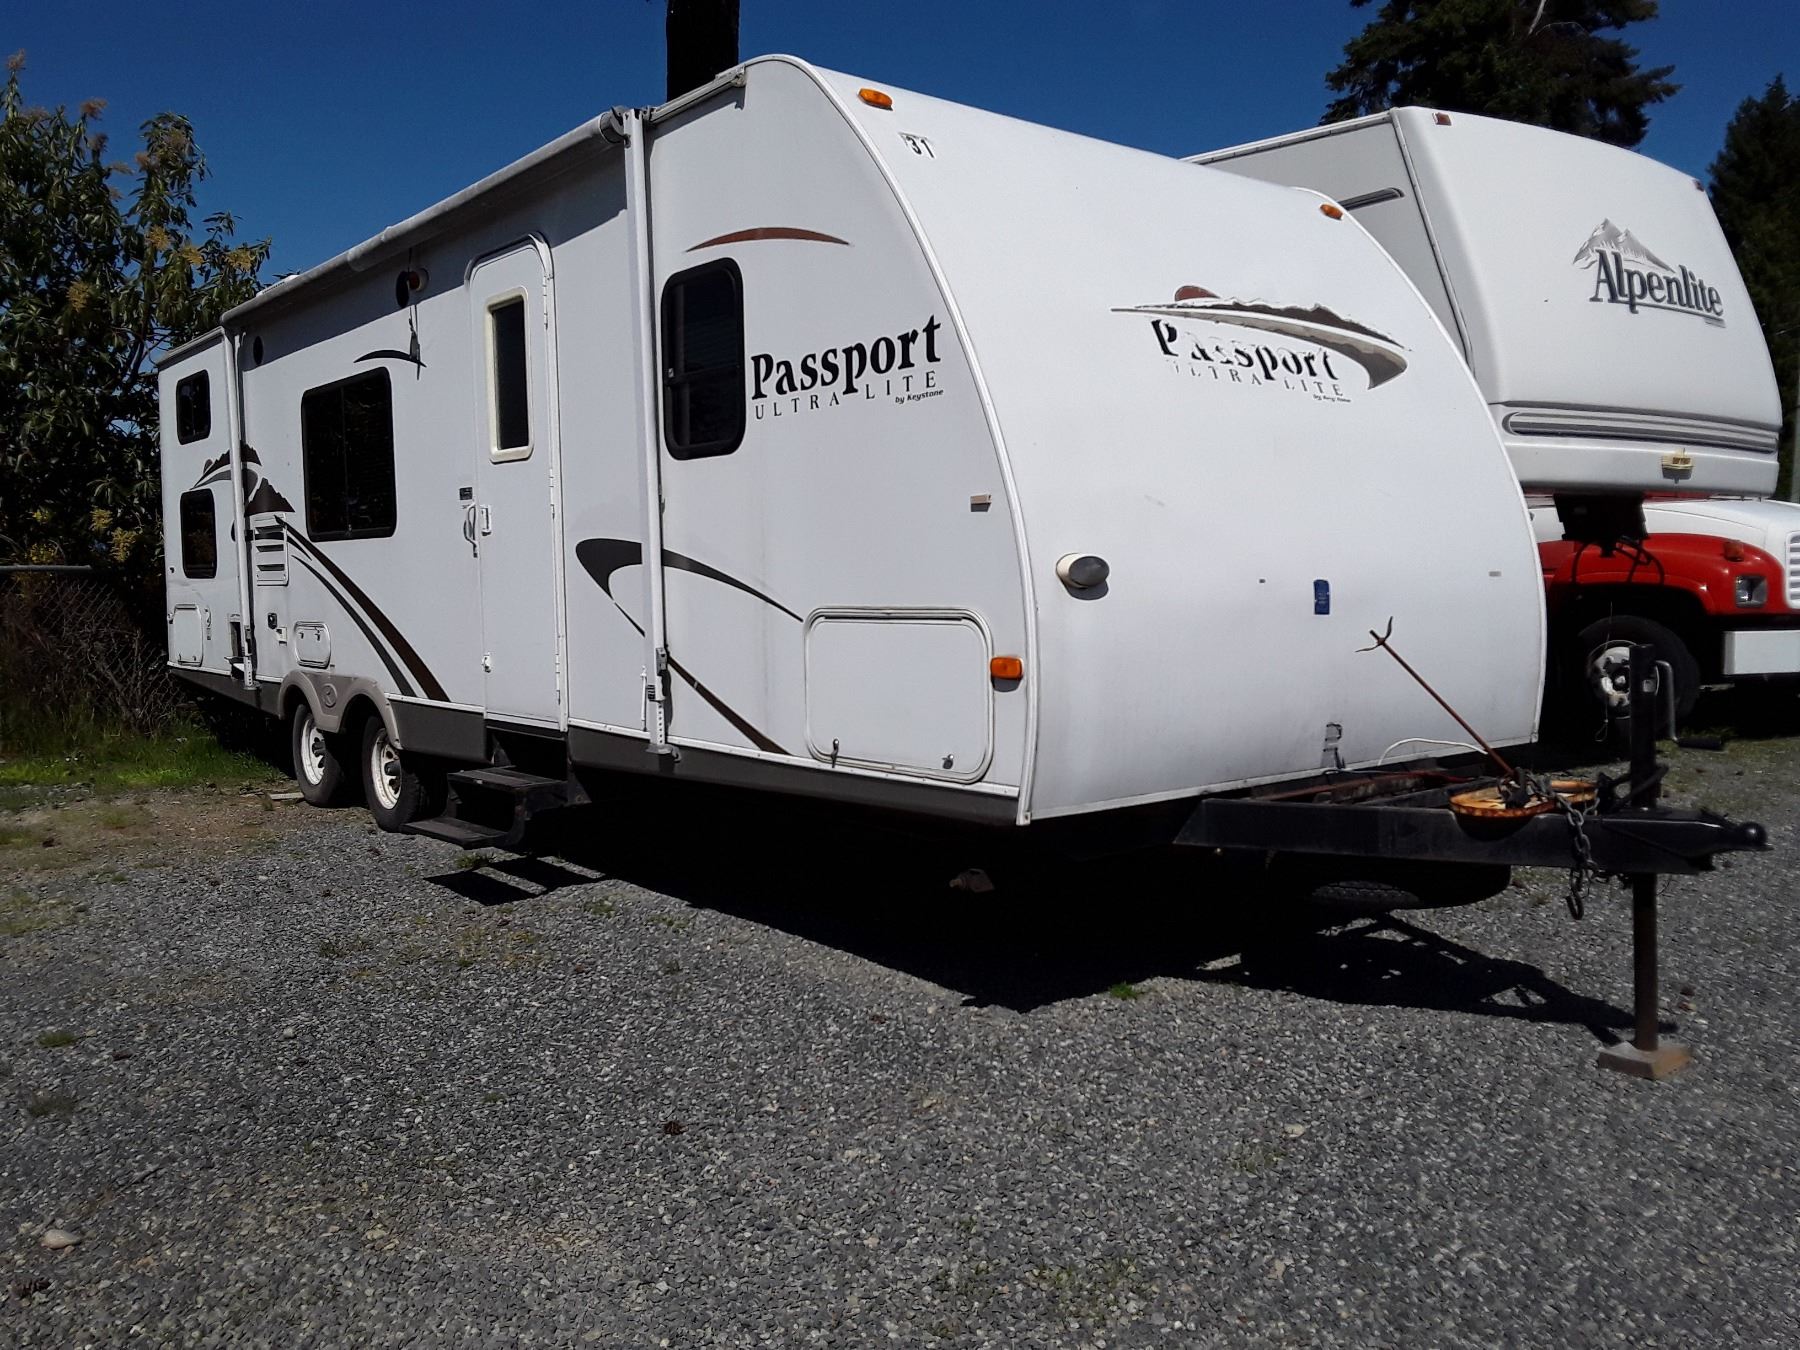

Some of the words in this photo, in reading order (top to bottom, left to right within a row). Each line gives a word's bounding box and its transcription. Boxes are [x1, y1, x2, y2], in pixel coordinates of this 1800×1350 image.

[905, 135, 934, 159] 31
[1589, 248, 1725, 317] Alpenlite
[750, 314, 942, 401] Passport
[755, 391, 840, 420] ULTRA
[865, 370, 937, 400] LITE
[895, 396, 905, 405] by
[907, 389, 944, 402] Keystone
[1282, 377, 1343, 396] LITE
